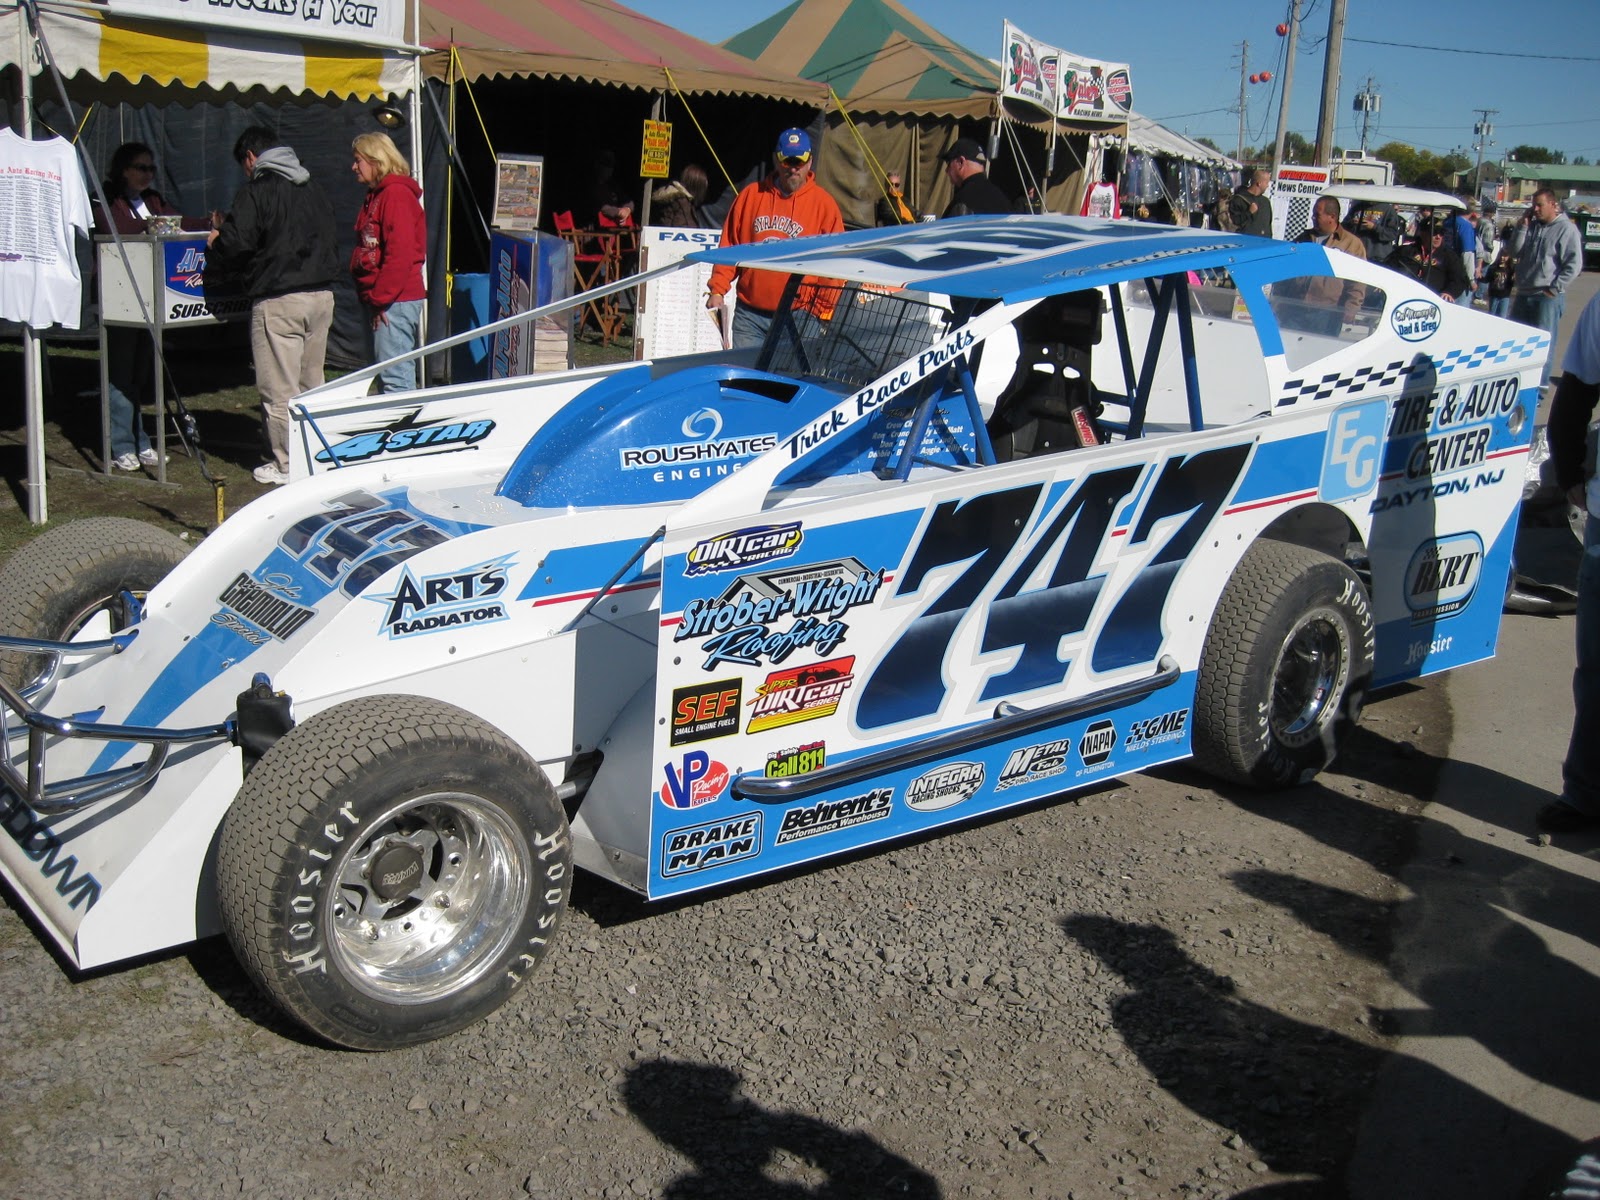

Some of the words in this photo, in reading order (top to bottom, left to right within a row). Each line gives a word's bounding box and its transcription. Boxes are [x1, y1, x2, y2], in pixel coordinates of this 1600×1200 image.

[303, 0, 322, 20] A
[333, 0, 377, 27] Year
[1277, 182, 1297, 193] News
[753, 215, 803, 238] SYRACUSE
[1413, 321, 1420, 333] &
[780, 410, 849, 459] Trick
[856, 370, 912, 416] Race
[918, 329, 979, 377] Parts
[1387, 390, 1439, 438] TIRE
[1438, 388, 1461, 425] &
[1459, 376, 1520, 422] AUTO
[623, 435, 777, 467] ROUSHYATES
[1406, 426, 1491, 480] CENTER
[1368, 480, 1471, 515] DAYTON,
[1474, 468, 1505, 489] NJ
[693, 525, 798, 563] DIRTcar
[856, 441, 1254, 730] 747
[1411, 551, 1480, 596] BERT
[393, 606, 503, 634] RADIATOR
[675, 567, 886, 642] Strober-Wright
[701, 617, 849, 671] Roofing
[1403, 633, 1453, 665] Hoosier
[674, 688, 739, 726] SEF
[754, 678, 852, 714] DIRTcar
[802, 694, 841, 710] SERIES
[674, 725, 695, 736] SMALL
[695, 720, 717, 732] ENGINE
[717, 717, 736, 729] FUELS
[1083, 729, 1112, 751] NAPA
[1145, 709, 1189, 741] GME
[767, 754, 799, 778] Call
[798, 748, 824, 775] 811
[999, 739, 1071, 782] METAL
[1015, 775, 1029, 786] PRO
[1029, 771, 1048, 784] RACE
[1048, 765, 1067, 779] SHOP
[663, 749, 710, 809] VP
[693, 771, 730, 799] Racing
[908, 763, 984, 796] INTEGRA
[911, 786, 936, 805] RACING
[935, 783, 961, 800] SHOCKS
[693, 795, 718, 806] FUELS
[781, 787, 893, 832] Behrent's
[669, 817, 756, 852] BRAKE
[780, 821, 838, 843] Performance
[838, 809, 888, 828] Warehouse
[668, 838, 755, 871] MAN
[281, 801, 361, 975] Hoosier
[507, 829, 570, 989] Hoosier
